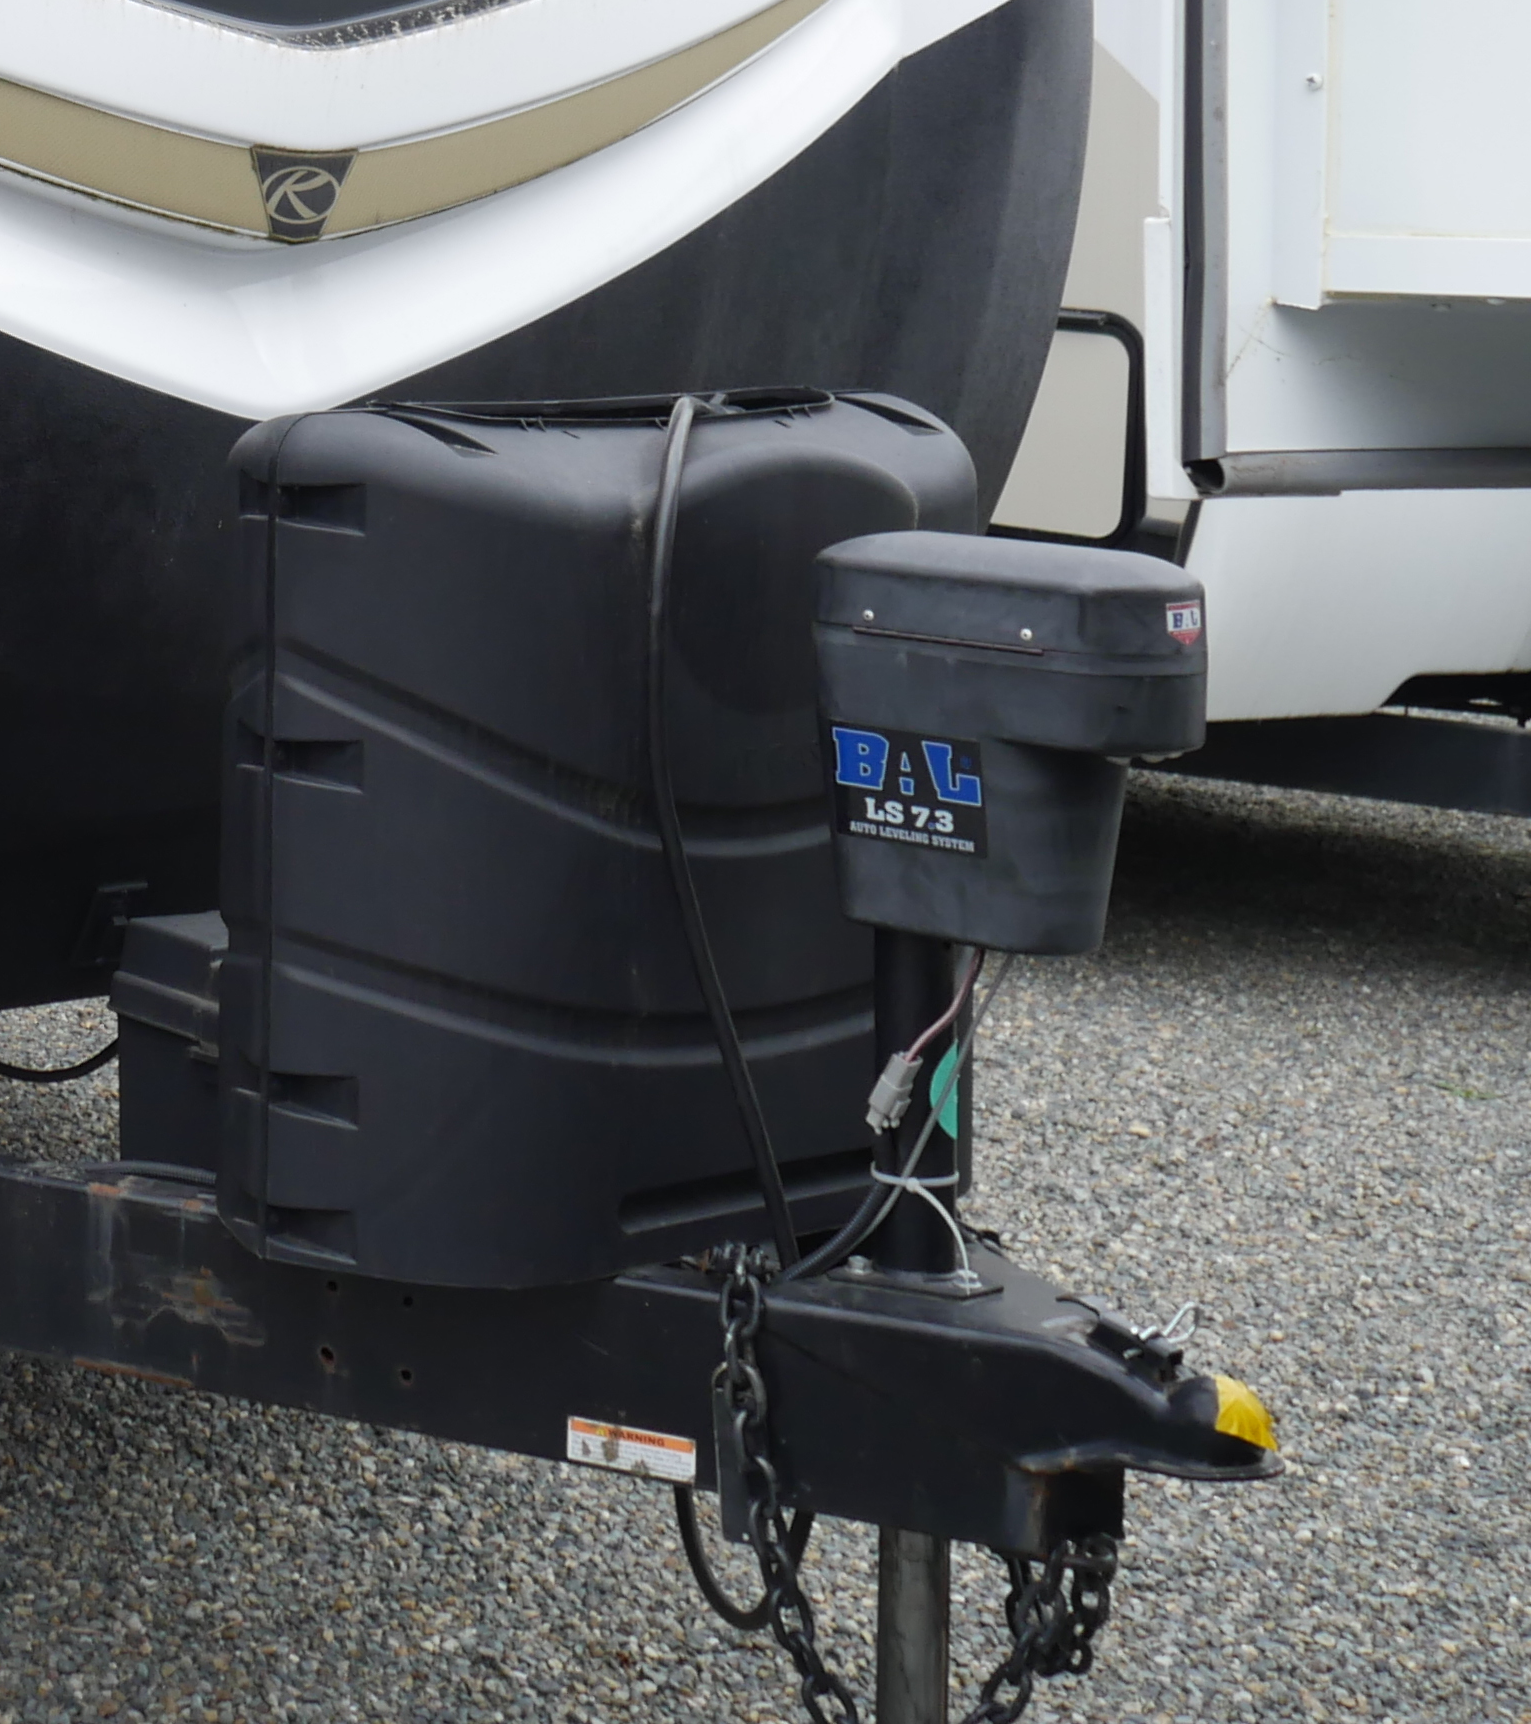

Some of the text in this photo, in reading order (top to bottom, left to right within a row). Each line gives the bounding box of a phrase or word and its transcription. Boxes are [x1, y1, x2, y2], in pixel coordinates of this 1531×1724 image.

[864, 796, 905, 825] LS
[849, 820, 975, 853] AUTO LEVELING SYSTEM
